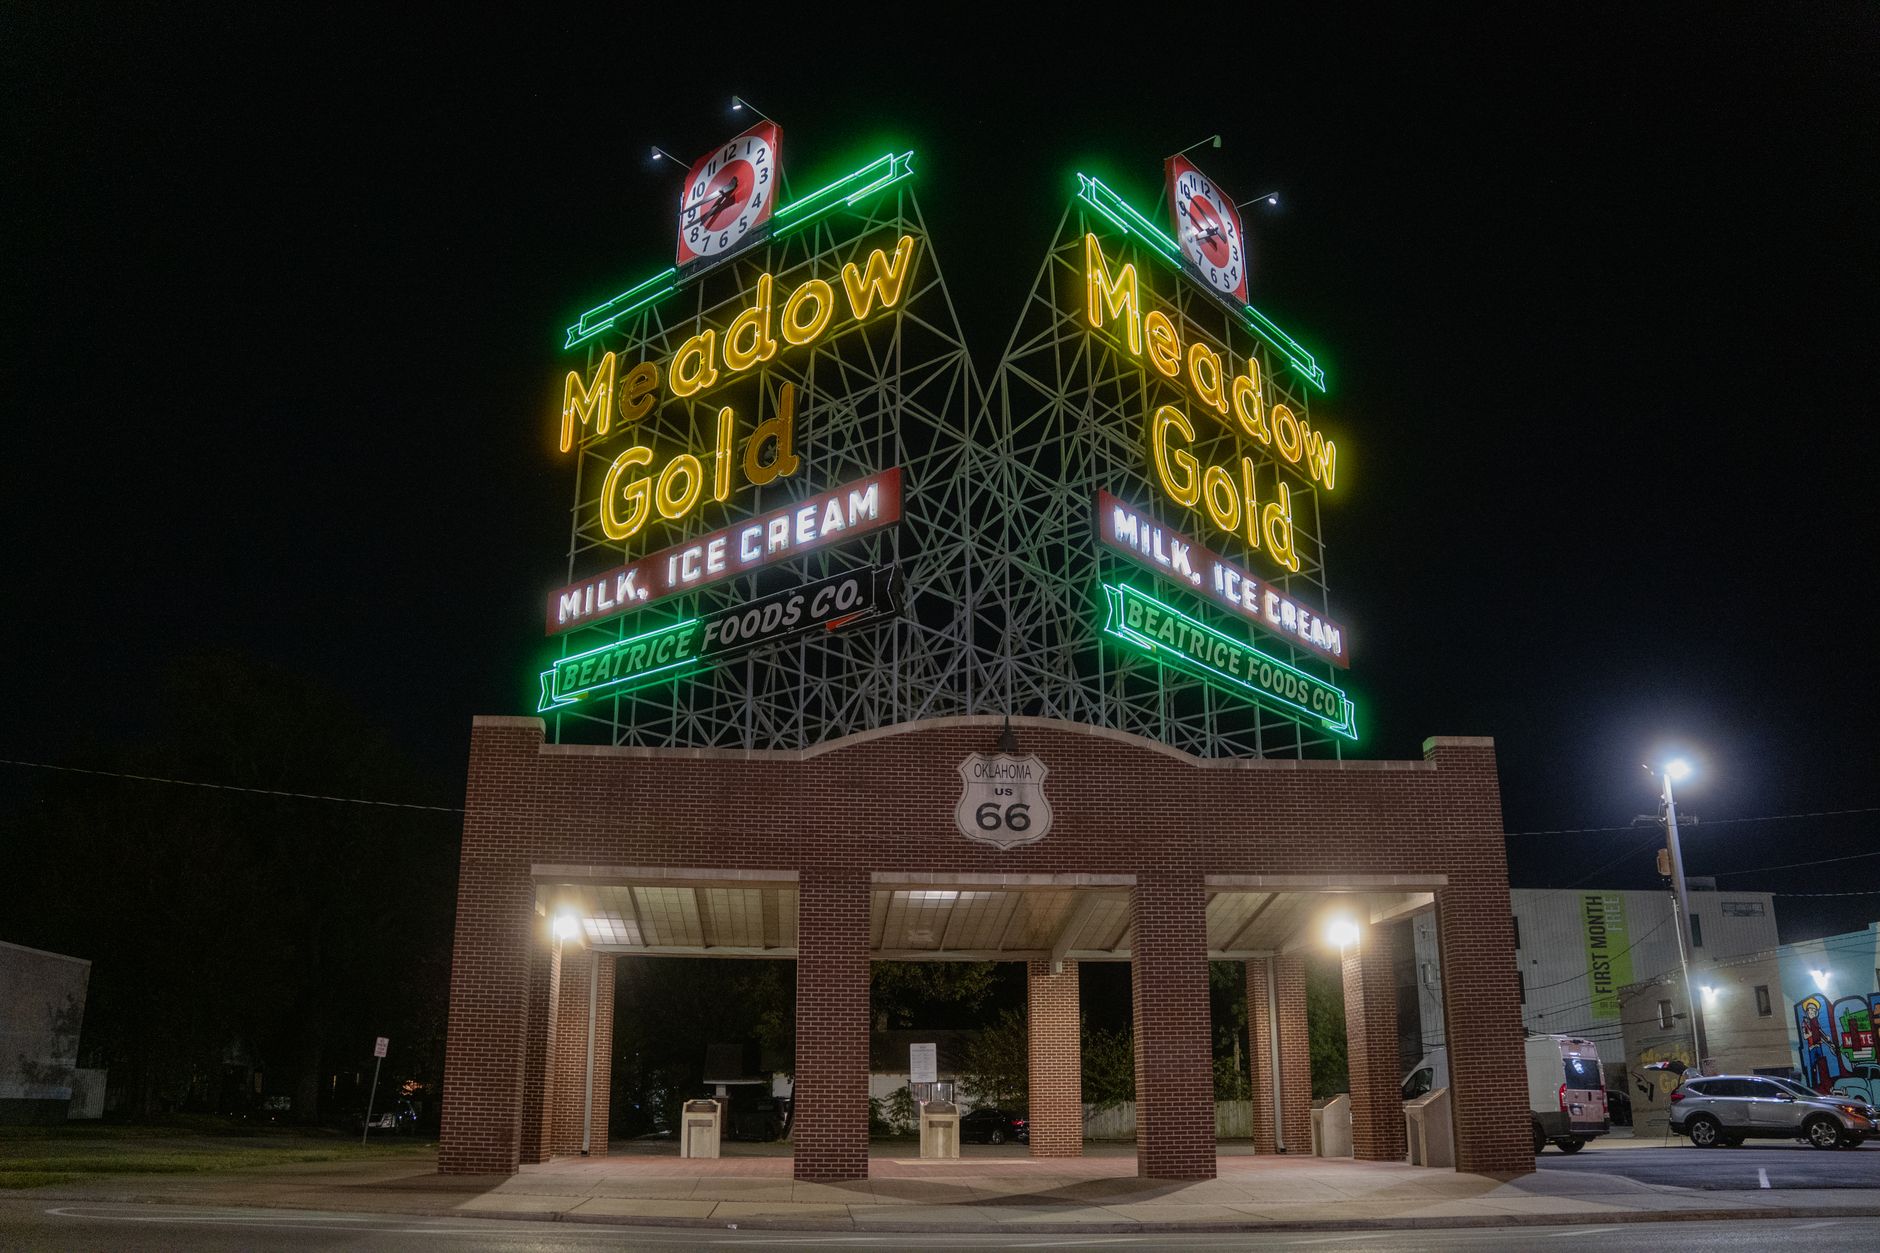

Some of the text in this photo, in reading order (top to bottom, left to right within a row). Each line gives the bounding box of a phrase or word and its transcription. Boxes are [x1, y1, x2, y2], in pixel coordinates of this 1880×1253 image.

[723, 144, 737, 163] 12
[746, 140, 752, 155] 1
[756, 147, 766, 166] 2
[707, 159, 717, 177] 11
[759, 166, 769, 185] 3
[691, 181, 706, 201] 10
[1179, 180, 1191, 200] 10
[1189, 174, 1197, 192] 11
[1200, 180, 1212, 200] 12
[751, 192, 762, 210] 4
[1178, 200, 1187, 217] 9
[1217, 200, 1222, 214] 1
[687, 208, 697, 224] 9
[738, 215, 748, 234] 5
[689, 226, 699, 244] 8
[719, 230, 729, 249] 6
[1226, 221, 1234, 239] 2
[702, 235, 711, 253] 7
[1231, 245, 1239, 262] 3
[1195, 249, 1203, 266] 7
[1210, 267, 1218, 284] 6
[1223, 272, 1230, 290] 5
[1230, 266, 1237, 281] 4
[560, 235, 915, 453] Meadow
[1086, 232, 1336, 489] Meadow
[599, 381, 799, 541] Gold
[1152, 405, 1300, 573] Gold
[558, 482, 880, 625] MILK, ICE CREAM
[1113, 504, 1342, 656] MILK, ICE CREAM
[561, 579, 864, 691] BEATRICE FOODS CO.
[1127, 598, 1339, 719] BEATRICE FOODS CO.
[974, 763, 1032, 779] OKLAHOMA
[994, 788, 1013, 796] US
[975, 802, 1032, 832] 66
[1585, 896, 1608, 949] MONTH
[1603, 897, 1623, 932] FREE
[1592, 952, 1613, 994] FIRST
